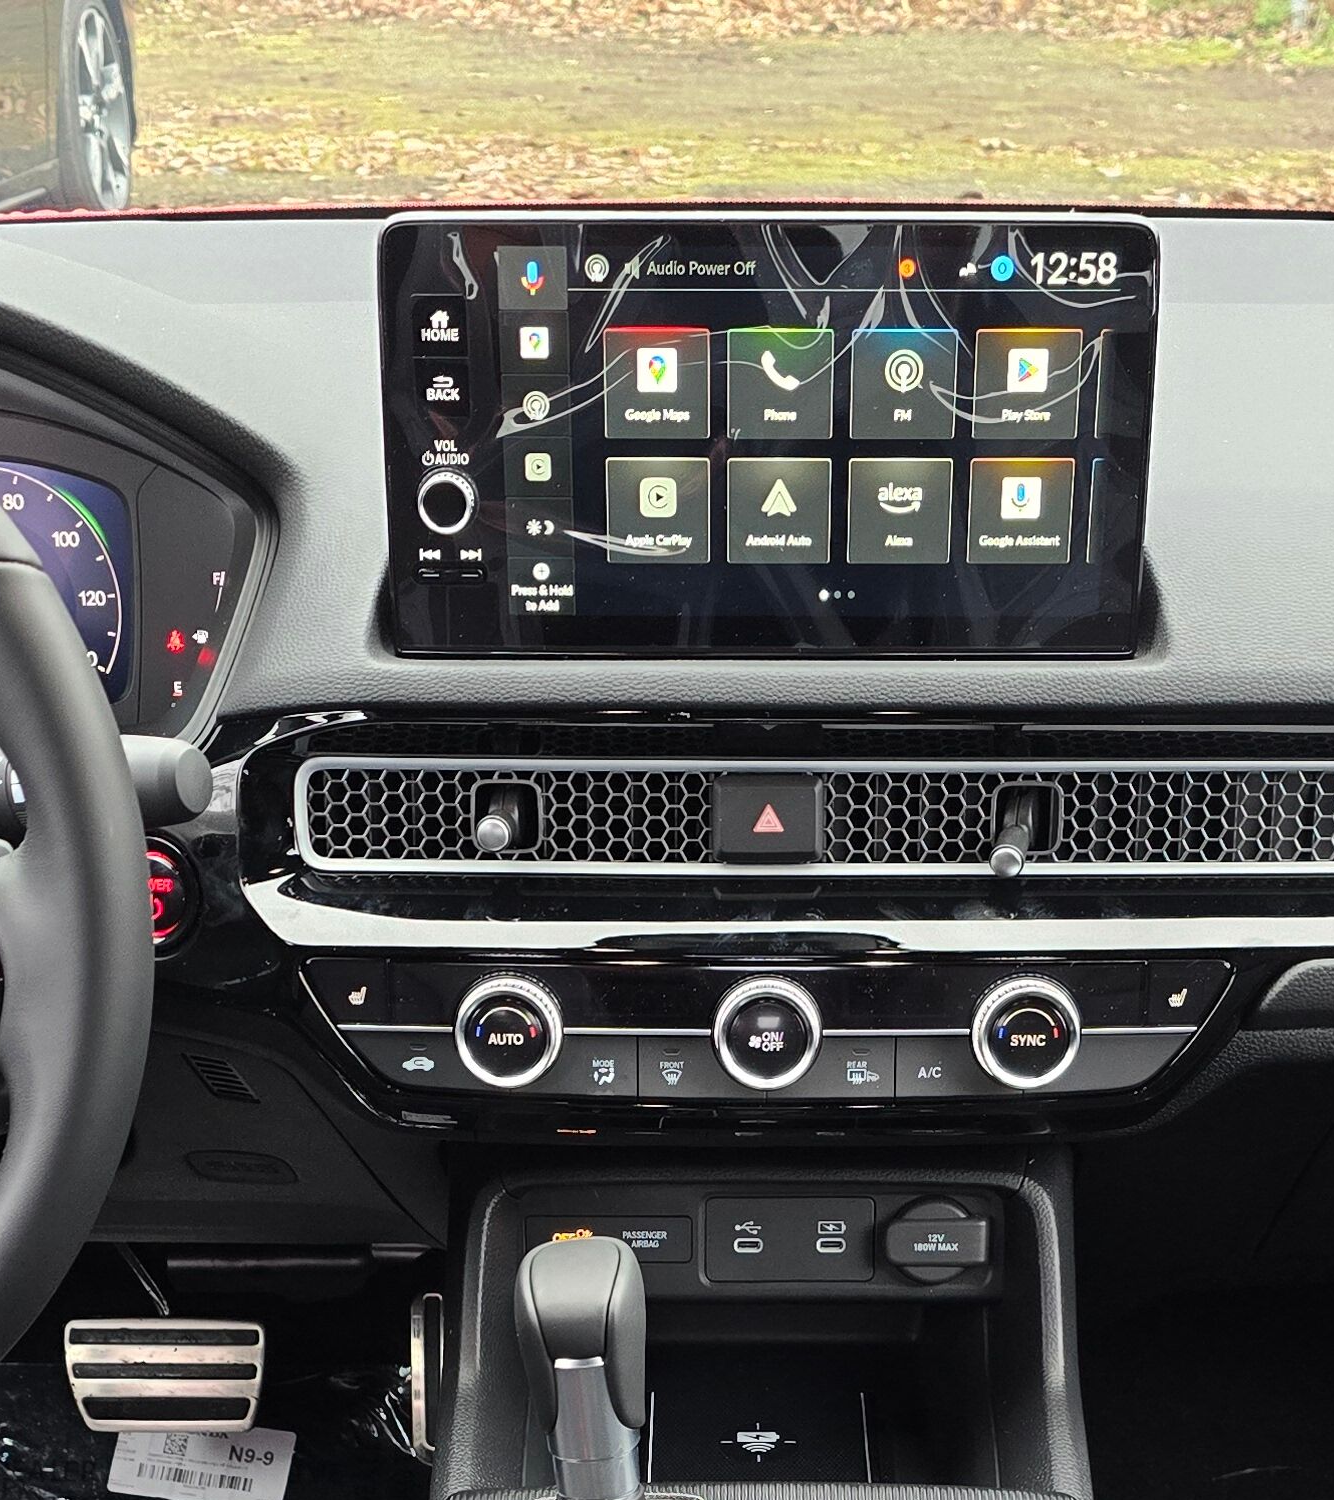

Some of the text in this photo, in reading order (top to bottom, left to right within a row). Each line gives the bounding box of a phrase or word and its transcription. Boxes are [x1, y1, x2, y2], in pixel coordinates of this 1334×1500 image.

[647, 260, 757, 276] Audio Power Off
[1031, 251, 1117, 286] 12:58
[421, 328, 460, 342] HOME
[425, 387, 460, 402] BACK
[624, 408, 691, 423] Google Maps
[763, 408, 797, 422] Phone
[893, 408, 913, 422] FM
[1001, 408, 1052, 423] Play Store
[433, 439, 458, 452] VOL
[434, 453, 470, 466] AUDIO
[877, 482, 923, 502] alexa
[2, 493, 25, 511] 80
[51, 531, 80, 548] 100
[624, 534, 693, 548] Apple CarPlay
[745, 534, 812, 547] Android Auto
[978, 535, 1061, 548] Google Assistant
[78, 590, 107, 607] 120
[488, 1033, 524, 1046] AUTO
[761, 1031, 784, 1042] ON/
[1010, 1034, 1047, 1047] SYNC
[761, 1041, 784, 1052] OFF
[592, 1059, 615, 1068] MODE
[659, 1061, 685, 1070] FRONT
[846, 1060, 868, 1069] REAR
[917, 1066, 942, 1079] A/C
[622, 1230, 668, 1240] PASSENGER
[927, 1234, 945, 1242] 12V
[631, 1239, 660, 1249] AIRBAG
[913, 1242, 959, 1252] 180W MAX
[229, 1445, 275, 1466] N9-9
